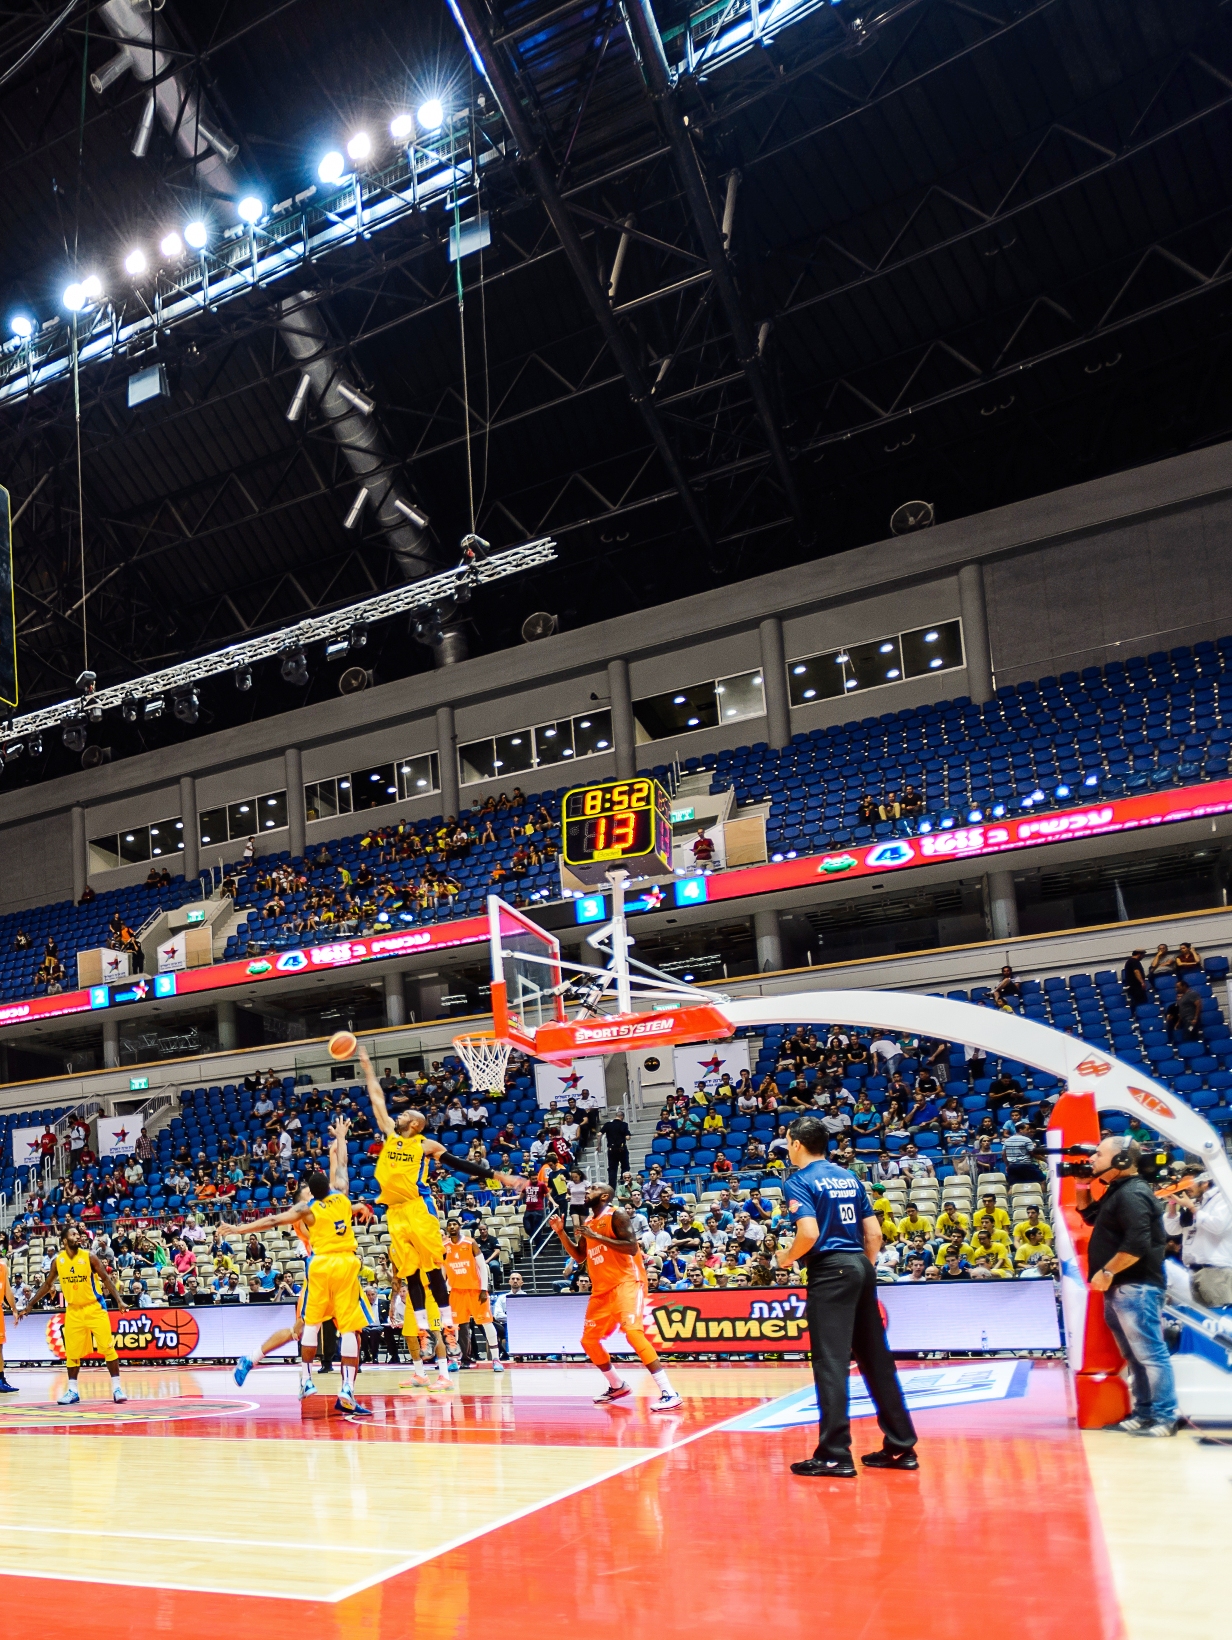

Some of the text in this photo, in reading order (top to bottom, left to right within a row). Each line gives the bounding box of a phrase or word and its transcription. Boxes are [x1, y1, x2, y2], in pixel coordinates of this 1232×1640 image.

[584, 782, 649, 816] 8:52
[1017, 806, 1113, 838] עכשיו
[596, 811, 636, 851] 13
[683, 882, 700, 899] 4
[584, 900, 599, 917] 3
[160, 980, 171, 992] 3
[94, 990, 105, 1003] 2
[576, 1019, 675, 1044] SPORTSYSTEM
[1134, 1092, 1164, 1114] ACE
[397, 1141, 403, 1150] 9
[557, 1143, 569, 1154] 22
[842, 1206, 854, 1221] 20
[334, 1220, 347, 1236] 5
[454, 1252, 459, 1260] 4
[70, 1266, 75, 1274] 4
[752, 1295, 807, 1318] ליגת
[119, 1315, 152, 1334] ליגת
[433, 1318, 441, 1327] 15
[628, 1313, 635, 1324] 7
[655, 1309, 808, 1339] Winner
[154, 1328, 178, 1347] סל
